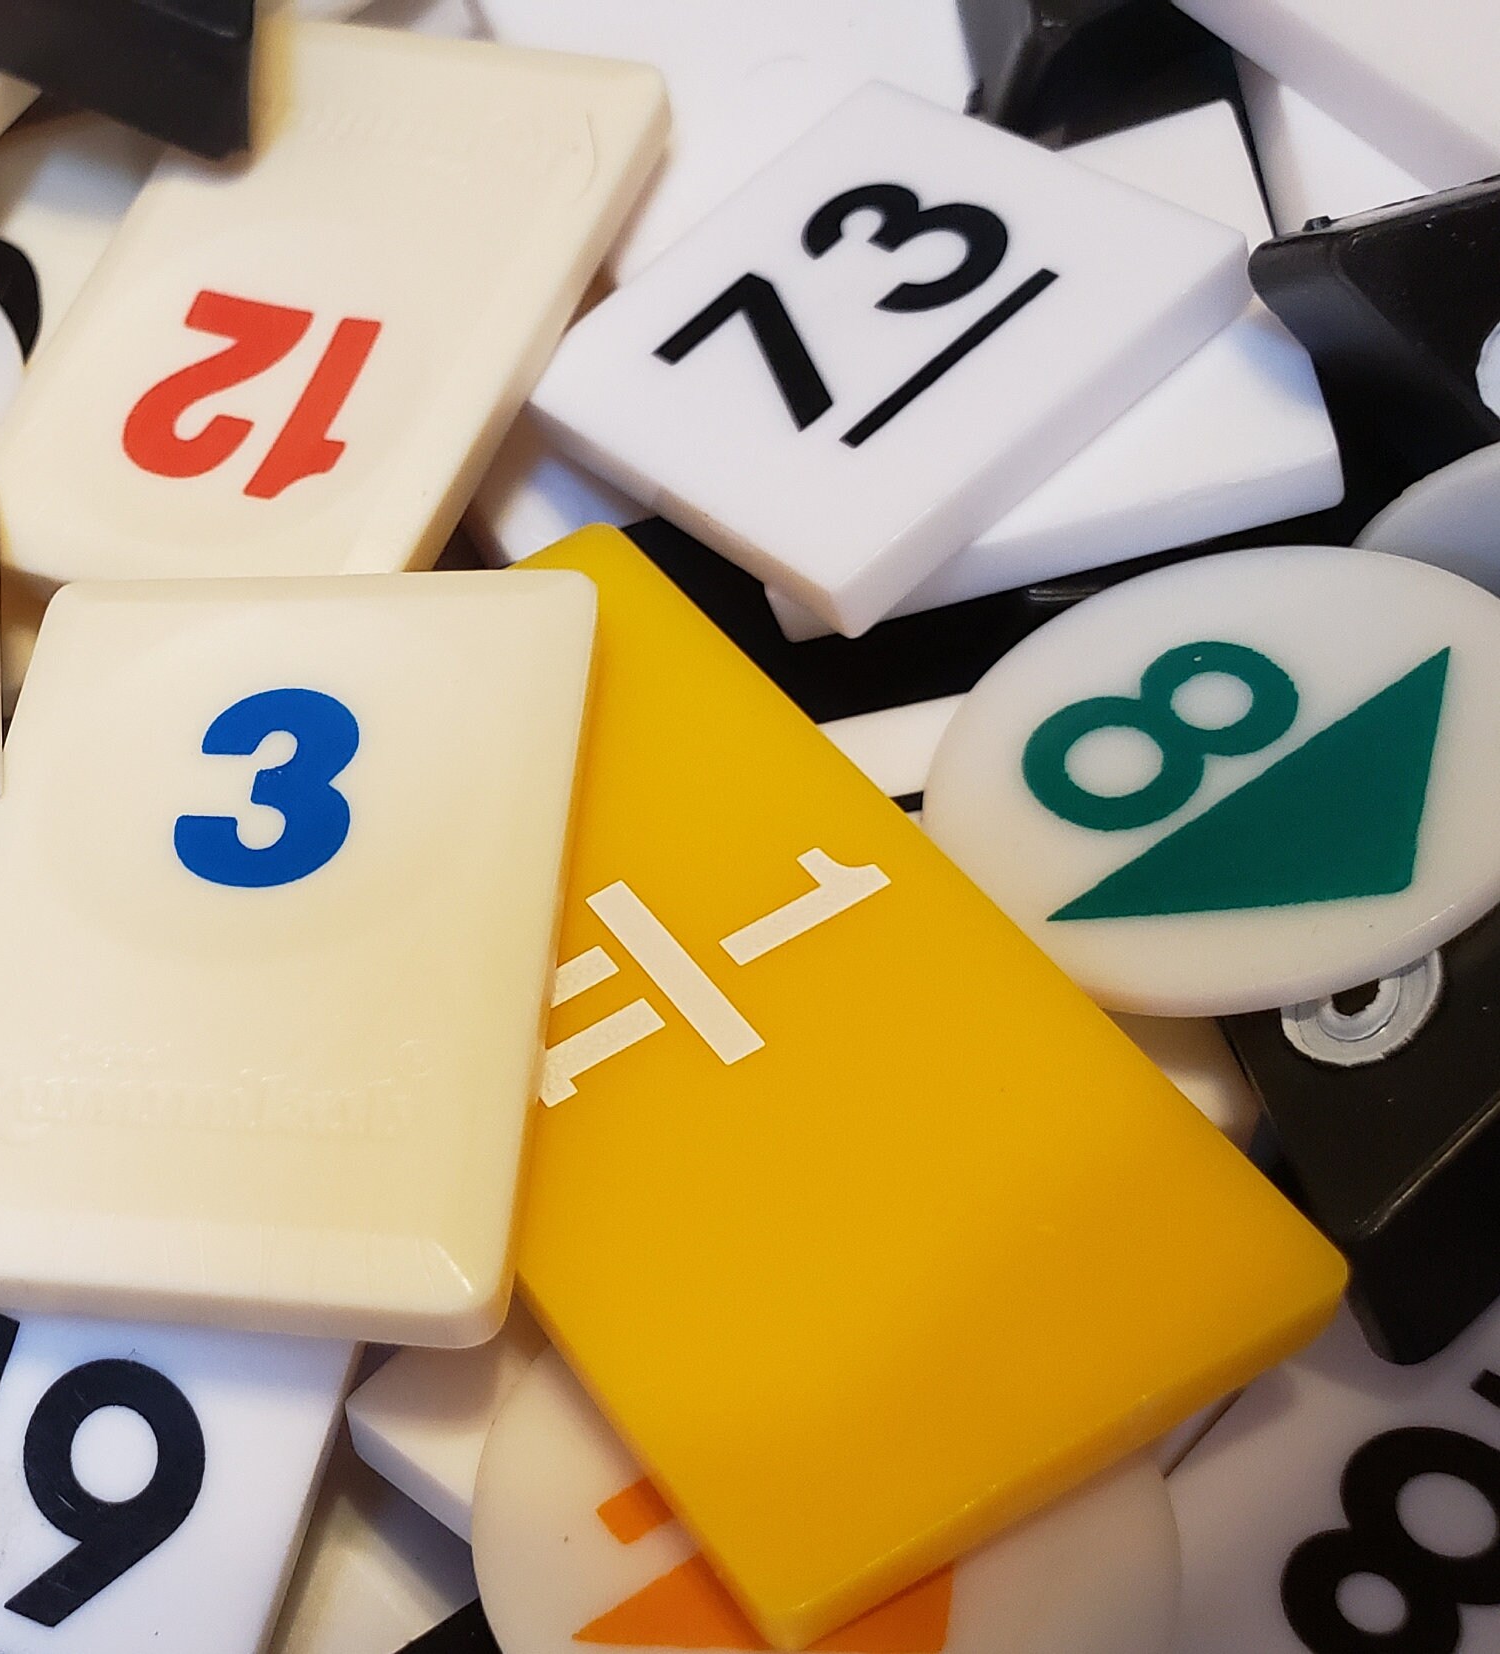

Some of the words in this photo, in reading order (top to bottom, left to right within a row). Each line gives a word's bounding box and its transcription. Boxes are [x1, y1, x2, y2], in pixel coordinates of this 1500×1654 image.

[122, 289, 383, 500] 12
[652, 183, 1009, 433] 73
[173, 687, 361, 889] 3
[1022, 641, 1299, 831] 8
